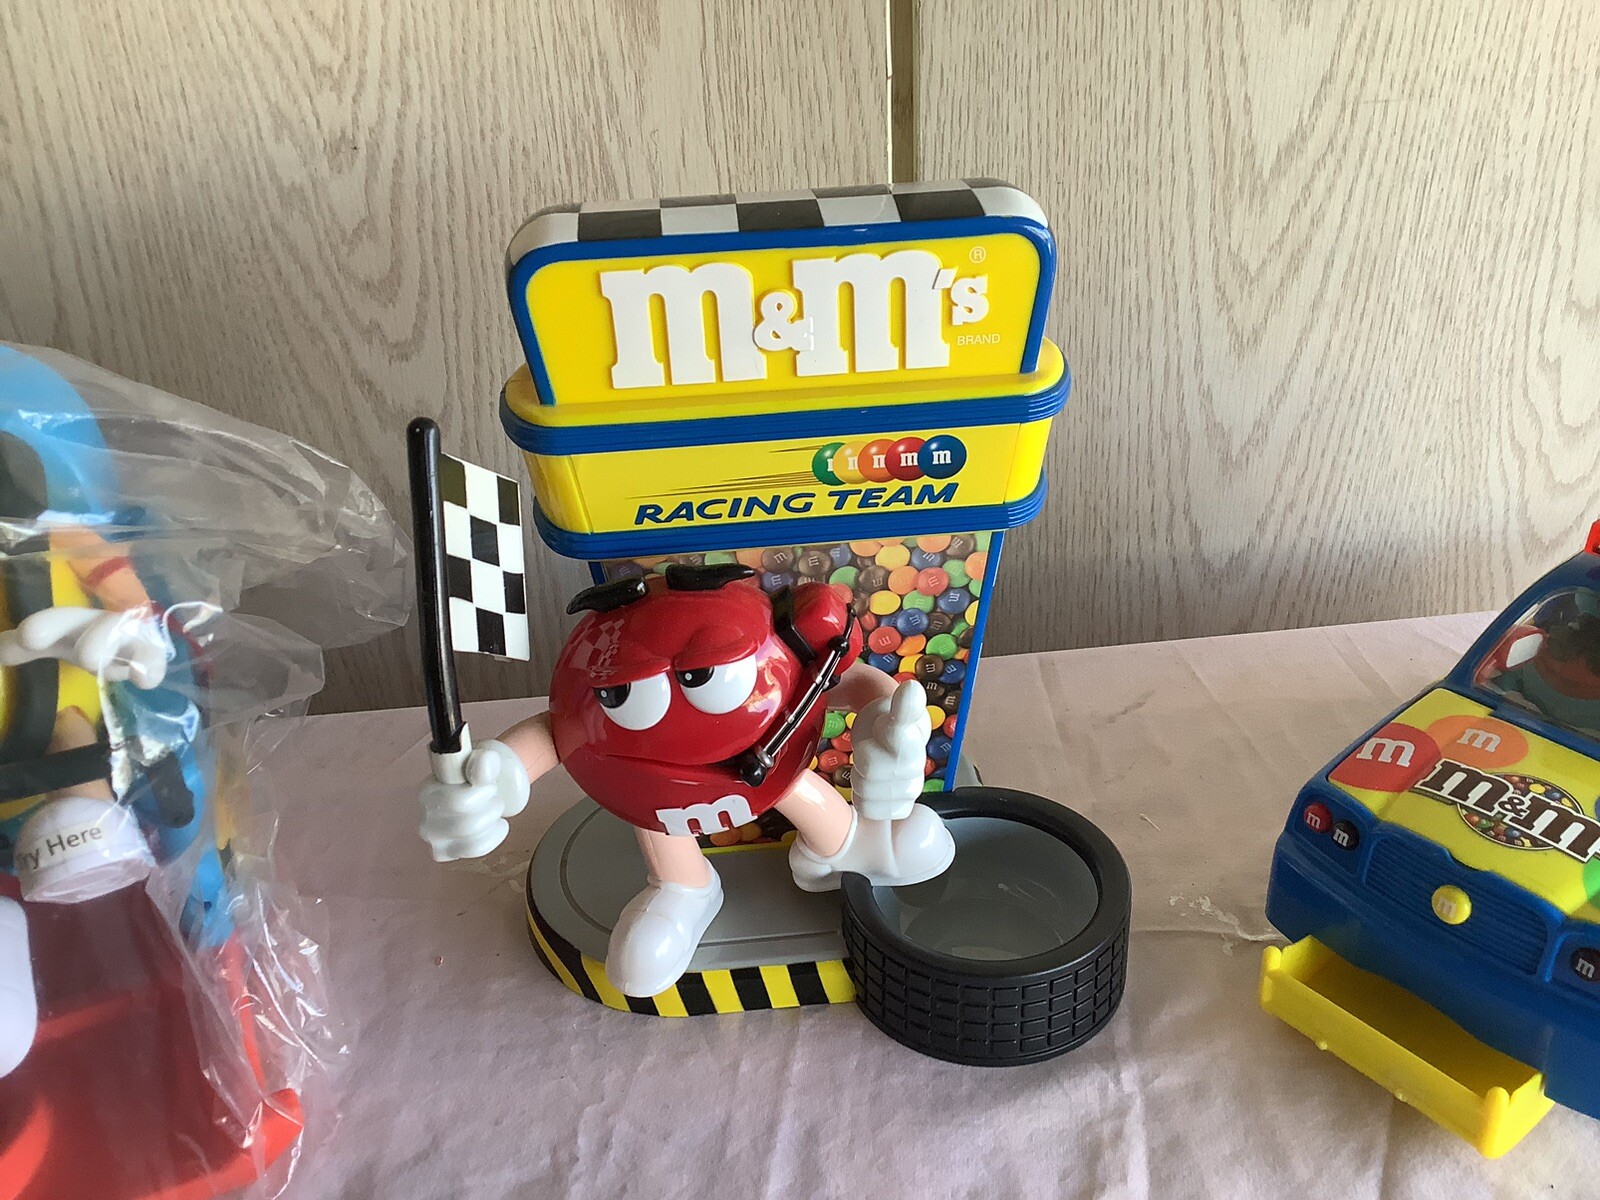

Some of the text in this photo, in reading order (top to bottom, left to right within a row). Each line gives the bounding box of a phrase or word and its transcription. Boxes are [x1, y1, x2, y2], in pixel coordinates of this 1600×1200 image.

[957, 333, 1001, 346] BRAND
[932, 449, 951, 465] m
[633, 482, 960, 526] RACING TEAM
[1356, 736, 1416, 768] m
[1456, 726, 1502, 753] m
[655, 794, 759, 838] m
[1305, 810, 1321, 829] m
[46, 826, 102, 856] Here
[1333, 827, 1350, 847] m
[1574, 957, 1596, 980] m
